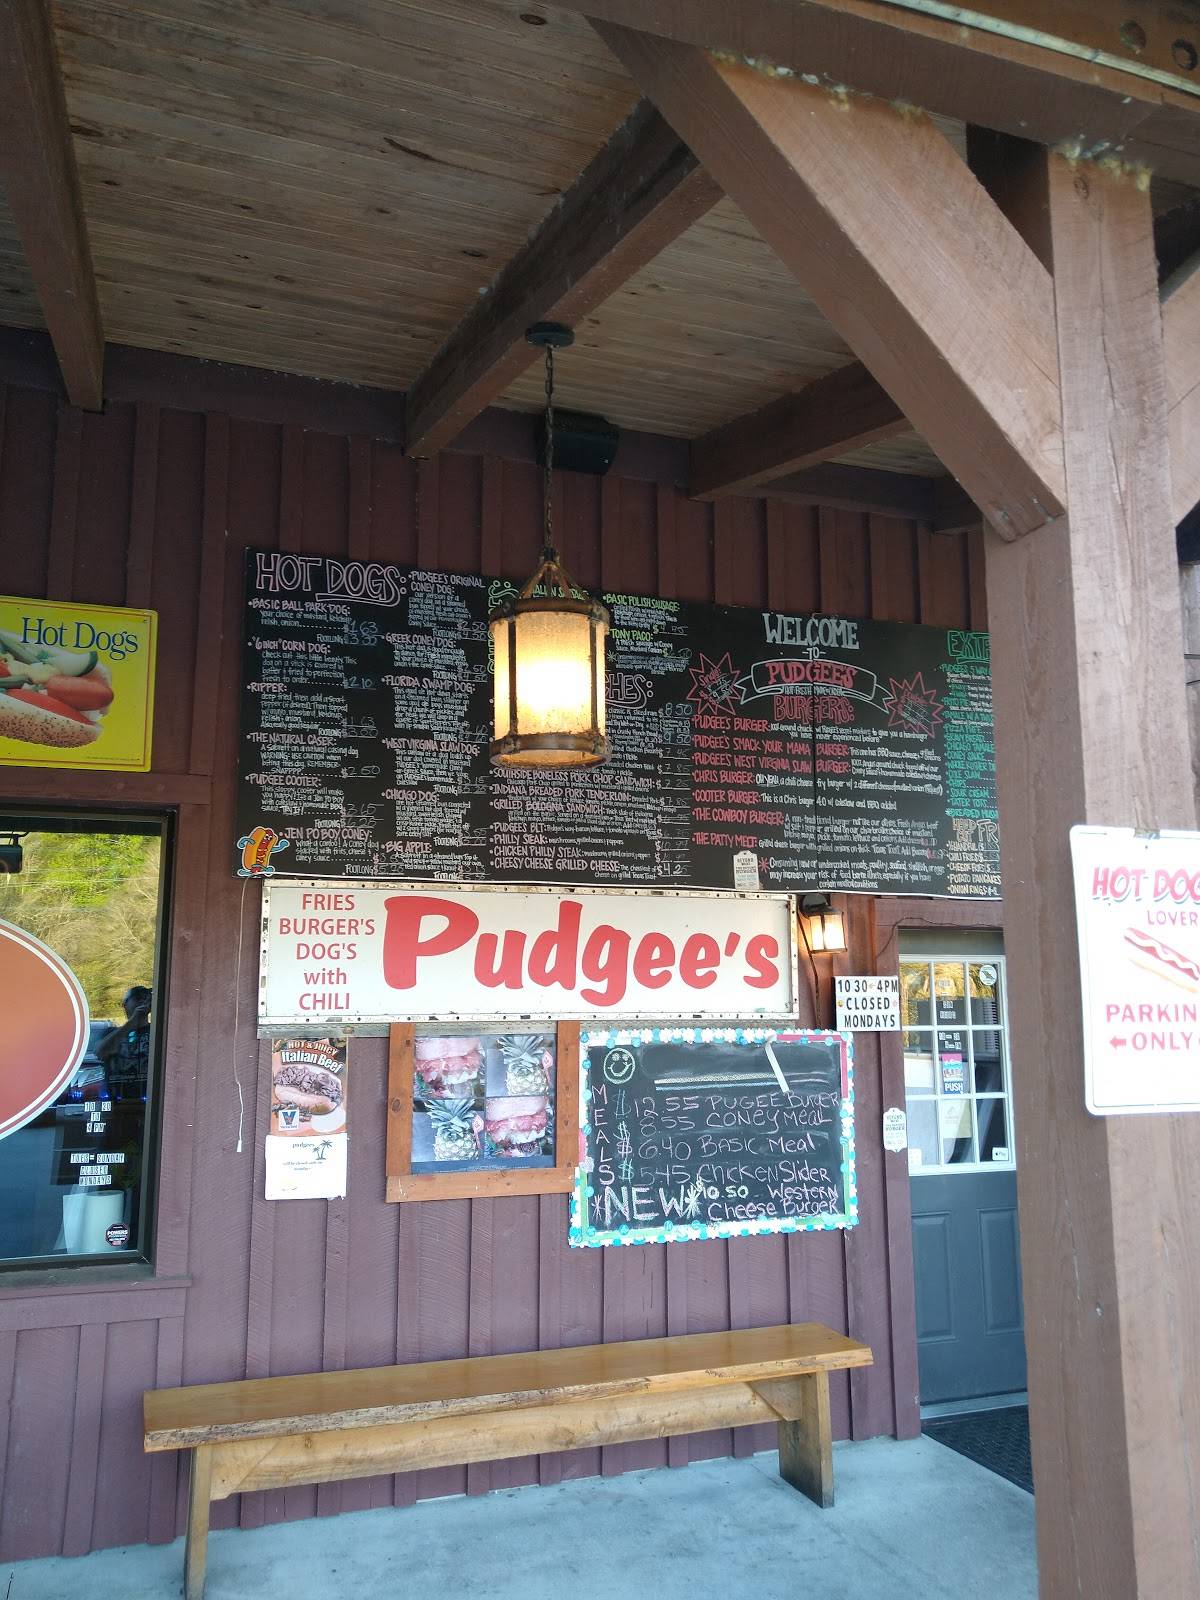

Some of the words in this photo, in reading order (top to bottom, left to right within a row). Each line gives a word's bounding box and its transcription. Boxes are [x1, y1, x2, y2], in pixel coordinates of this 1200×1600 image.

[256, 553, 321, 591] HOT
[411, 581, 435, 592] CONEY
[252, 598, 280, 610] BASIC
[282, 600, 303, 611] BALL
[304, 601, 327, 614] PARK
[606, 594, 627, 605] BASIC
[628, 596, 652, 607] POLISH
[21, 617, 67, 647] Hot
[73, 621, 139, 660] Dogs
[610, 628, 631, 641] TONY
[762, 613, 859, 649] WELCOME
[282, 640, 305, 652] CORN
[386, 632, 412, 644] GREEK
[412, 634, 436, 646] CONEY
[766, 661, 857, 688] PUDGEE'S
[250, 682, 287, 693] RIPPER:
[385, 675, 420, 687] FLORIDA
[422, 677, 453, 690] SWAMP
[250, 732, 269, 743] THE
[269, 733, 306, 745] NATURAL
[386, 737, 407, 749] WEST
[408, 738, 438, 751] VIRGINIA
[440, 741, 460, 752] SLAW
[733, 737, 761, 751] SMACK
[762, 740, 783, 754] YOUR
[786, 742, 811, 756] MAMA
[734, 755, 756, 768] WEST
[759, 756, 790, 771] VIRGINIA
[792, 760, 812, 773] SLAW
[250, 773, 284, 786] PUDGEE
[493, 767, 533, 780] SOUTHSIDE
[533, 770, 568, 781] BONELESS
[570, 771, 591, 783] PORK
[593, 774, 614, 785] CHOP
[693, 770, 718, 783] CHRIS
[385, 788, 416, 801] CHICAGO
[492, 783, 527, 794] INDIANA
[529, 786, 563, 797] BREADED
[564, 788, 585, 799] PORK
[694, 790, 727, 802] COOTER
[494, 799, 523, 810] GRILLED
[526, 801, 565, 813] BOLOGNA
[694, 807, 711, 820] THE
[712, 808, 748, 824] COWBOY
[284, 827, 304, 839] JEN
[306, 828, 320, 839] PO
[321, 829, 341, 840] BOY
[494, 834, 520, 845] PHILLY
[694, 833, 710, 845] THE
[710, 833, 734, 848] PATTY
[385, 841, 404, 853] BIG
[494, 845, 527, 856] CHICKEN
[529, 846, 555, 858] PHILLY
[494, 857, 524, 869] CHEESY
[525, 857, 554, 870] CHEESE
[555, 859, 588, 871] GRILLED
[1092, 866, 1146, 900] HOT
[301, 894, 355, 911] FRIES
[278, 917, 375, 936] BURGER'S
[296, 943, 357, 960] DOG'S
[383, 896, 779, 1007] Pudgee's
[303, 968, 347, 986] with
[877, 980, 898, 992] 4PM
[299, 993, 350, 1010] CHILI
[846, 997, 890, 1010] CLOSED
[844, 1014, 896, 1028] MONDAYS
[288, 1041, 304, 1049] HOT
[314, 1042, 339, 1056] JUICY
[1132, 1032, 1192, 1051] ONLY
[281, 1050, 317, 1064] Italian
[317, 1053, 344, 1074] Beef
[944, 1082, 963, 1092] PUSH
[705, 1092, 784, 1110] PUGEE
[698, 1134, 760, 1158] BASIC
[97, 1153, 124, 1163] SUNDAY
[80, 1165, 108, 1175] CLOSED
[79, 1175, 111, 1187] MONDAYS
